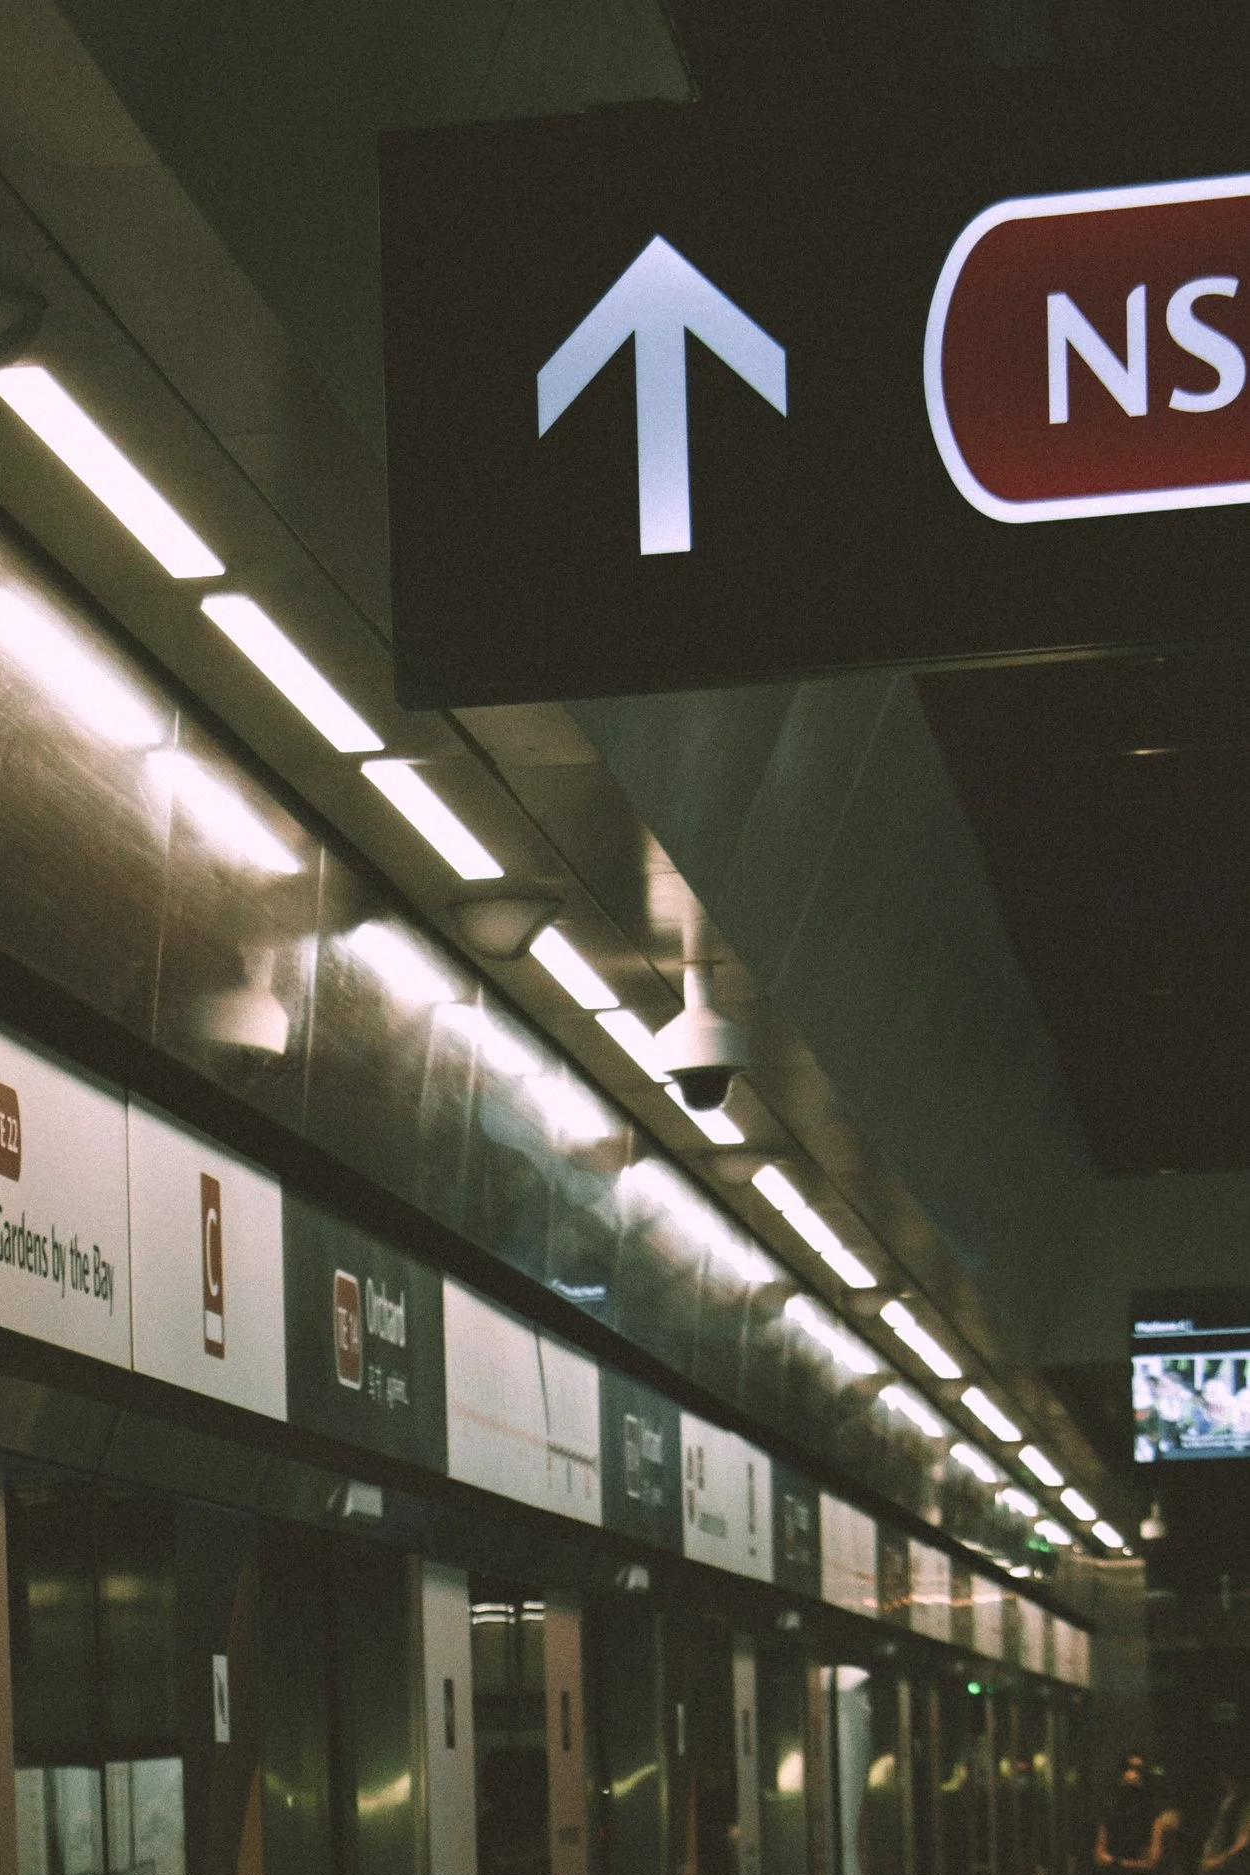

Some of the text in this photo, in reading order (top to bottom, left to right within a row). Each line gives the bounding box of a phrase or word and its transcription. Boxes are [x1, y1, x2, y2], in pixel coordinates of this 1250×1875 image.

[1046, 275, 1248, 425] NS
[7, 1116, 19, 1154] 22
[50, 1222, 67, 1300] by
[69, 1232, 91, 1295] the
[93, 1244, 116, 1318] Bay
[205, 1206, 220, 1298] C
